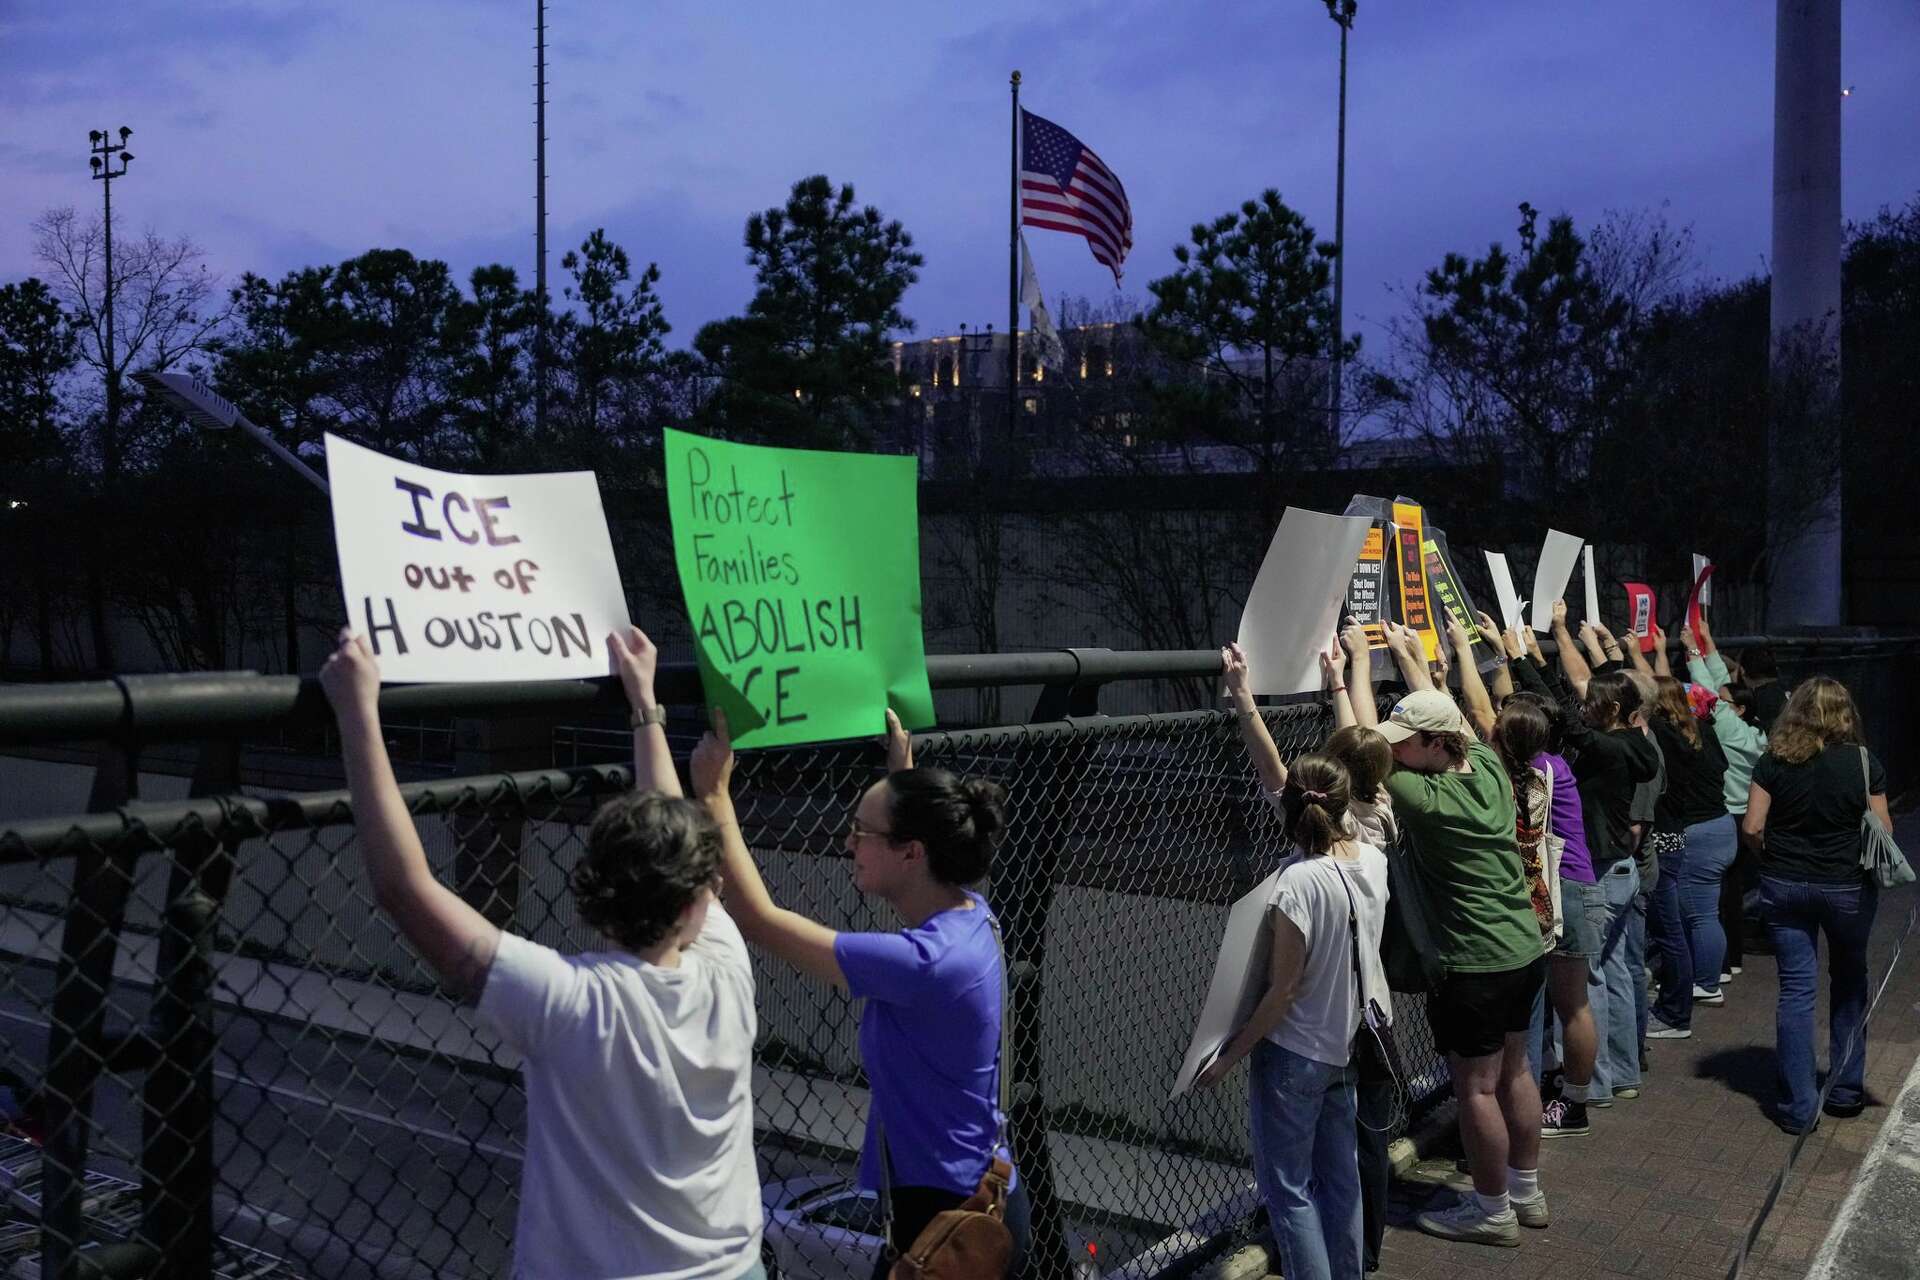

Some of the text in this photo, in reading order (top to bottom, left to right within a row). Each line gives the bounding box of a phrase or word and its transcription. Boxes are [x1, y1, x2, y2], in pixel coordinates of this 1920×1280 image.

[395, 476, 521, 547] ICE
[687, 447, 795, 527] Protect
[404, 558, 540, 595] out of
[693, 533, 799, 586] Families
[364, 596, 593, 659] HOUSTON
[699, 595, 863, 664] ABOLISH
[726, 666, 808, 726] CE
